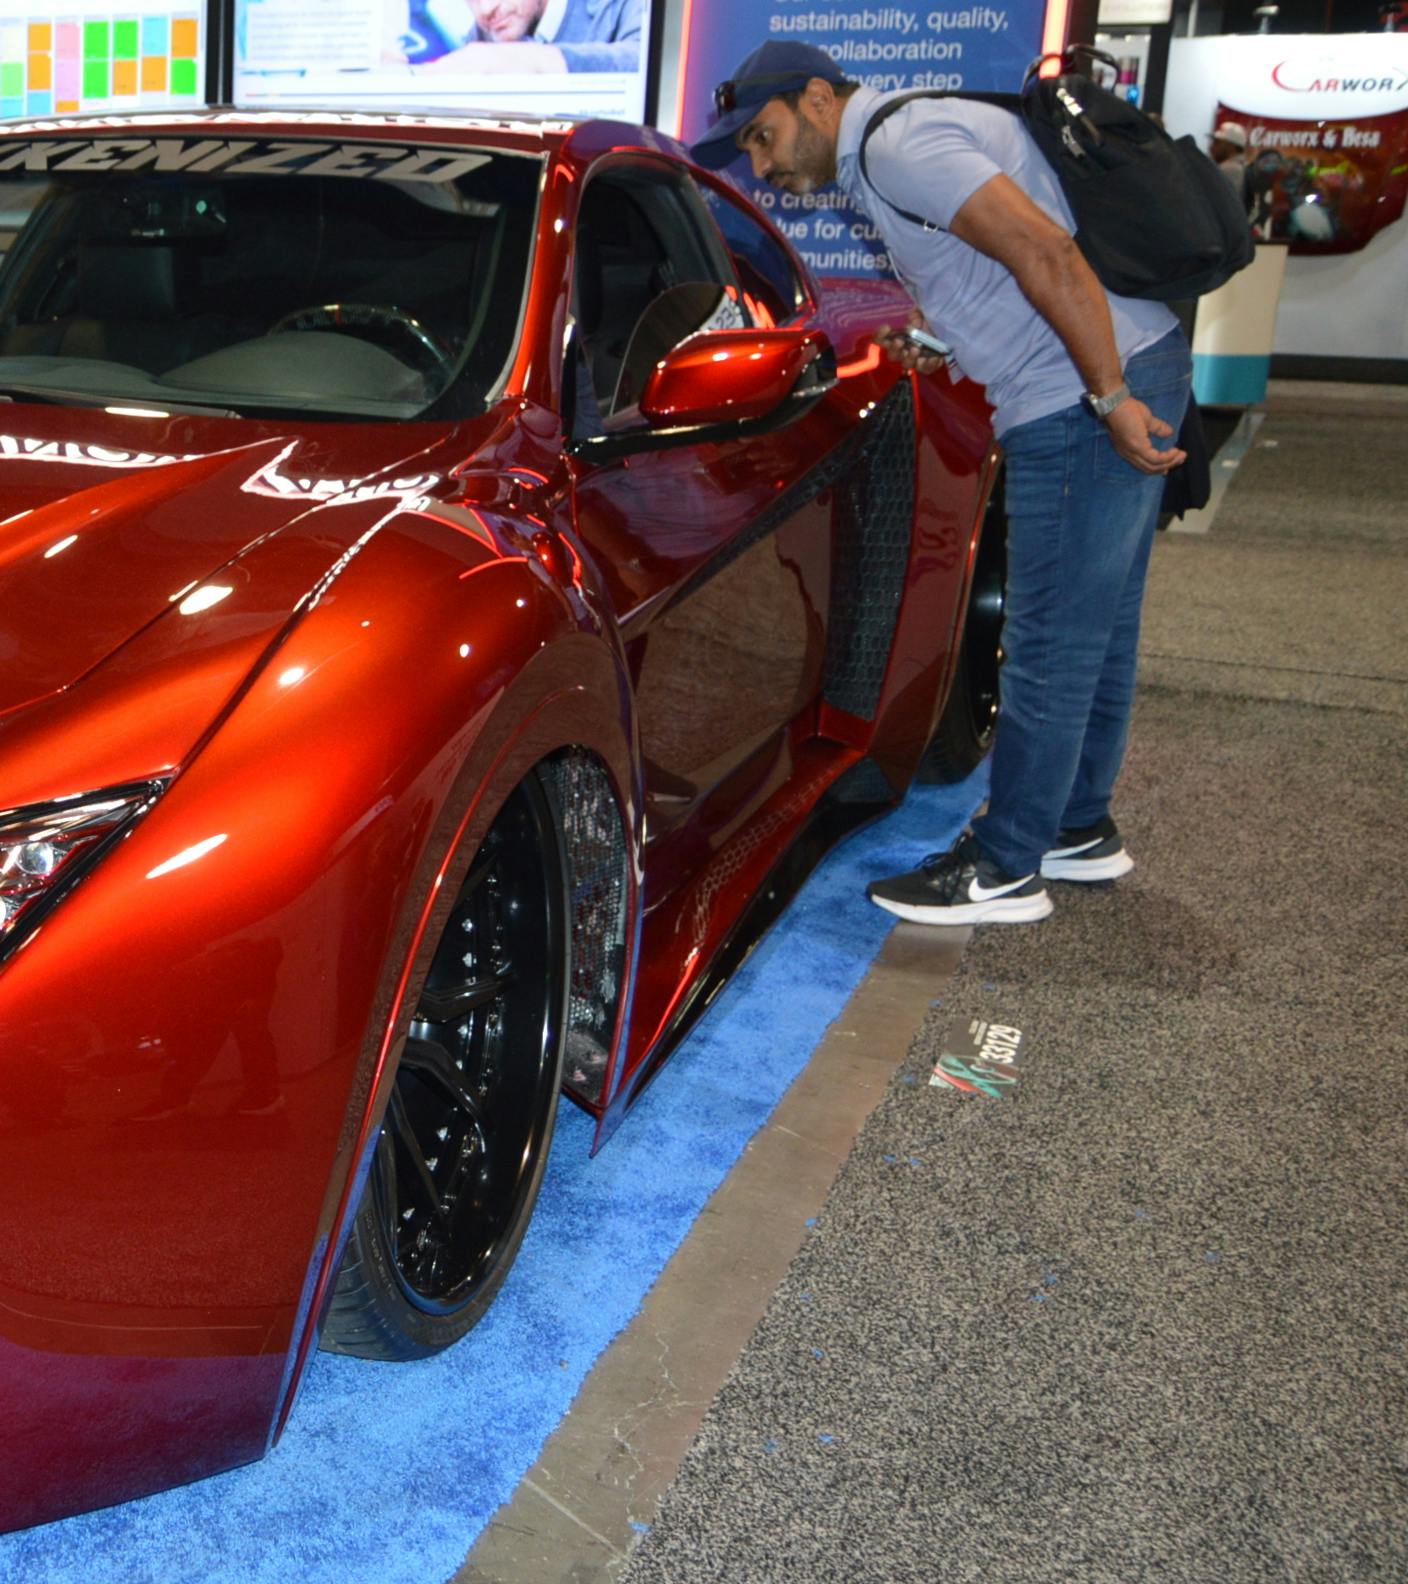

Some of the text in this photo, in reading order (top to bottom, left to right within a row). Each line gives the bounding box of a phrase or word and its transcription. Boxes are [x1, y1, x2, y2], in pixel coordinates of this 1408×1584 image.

[769, 7, 1009, 34] sustainability, quality,
[911, 69, 963, 91] step
[1249, 126, 1320, 148] Carworx
[1322, 129, 1337, 149] &
[753, 189, 864, 214] to creatin
[814, 218, 846, 239] for
[979, 1024, 1022, 1063] 33129
